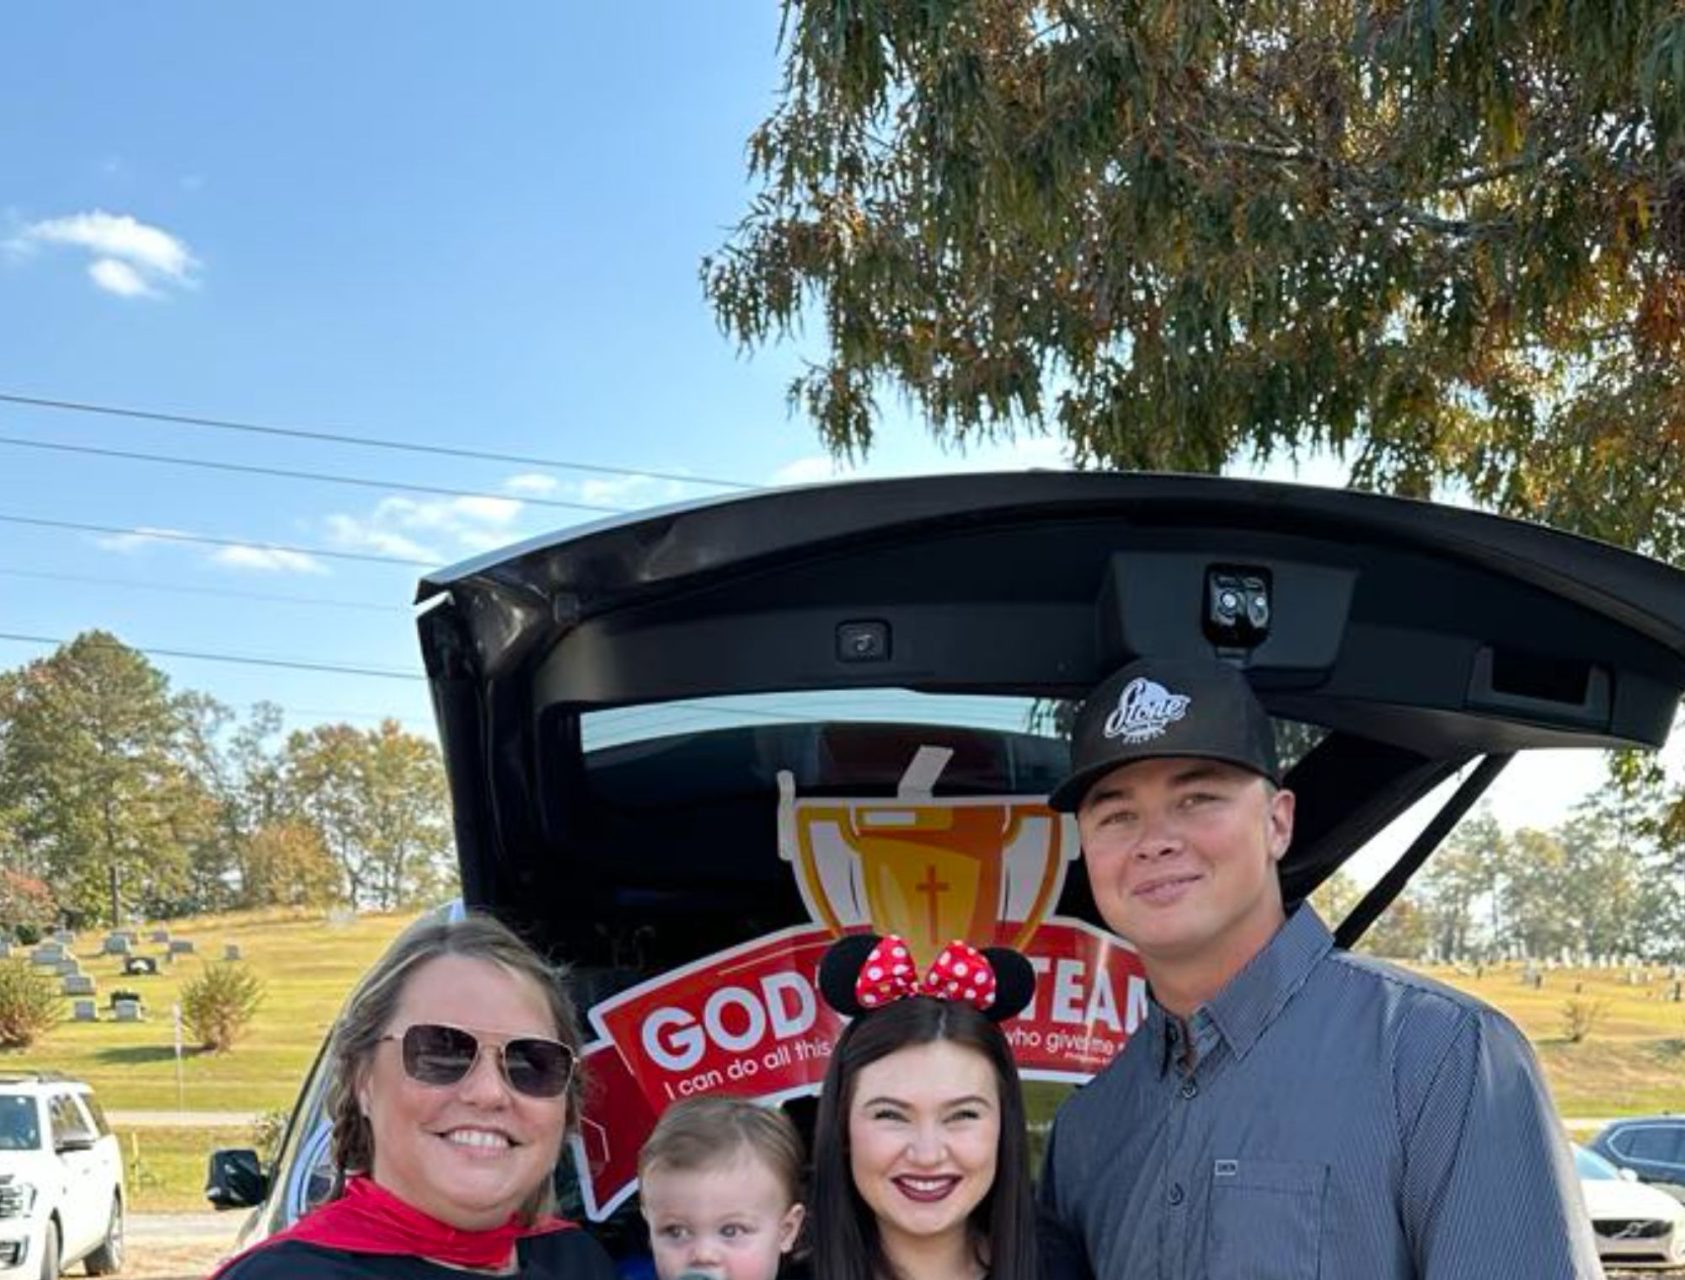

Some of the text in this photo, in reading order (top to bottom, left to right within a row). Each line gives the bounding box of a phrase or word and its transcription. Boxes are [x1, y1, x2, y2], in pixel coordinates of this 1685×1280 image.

[664, 1081, 677, 1101] I
[678, 1069, 724, 1096] can
[727, 1058, 759, 1080] do
[763, 1047, 791, 1070] all
[795, 1037, 832, 1061] this
